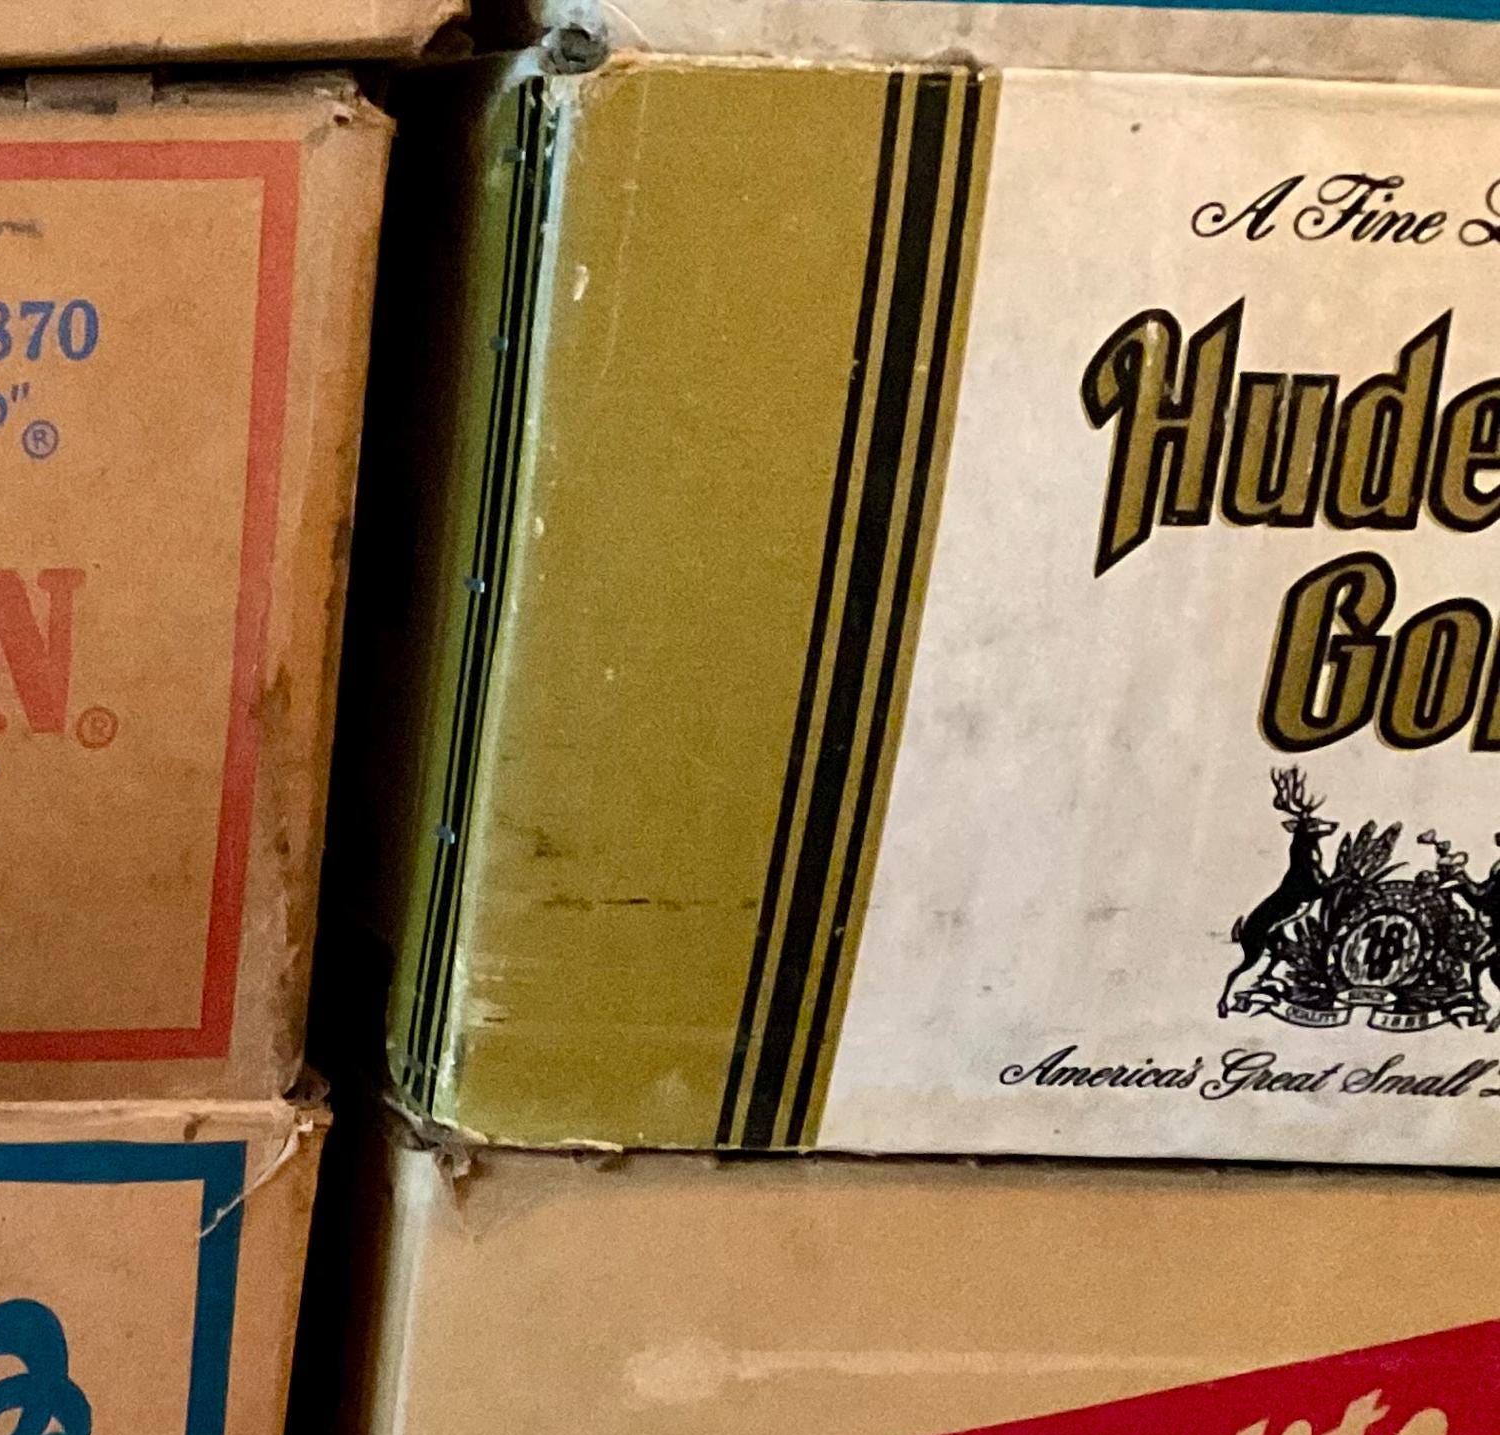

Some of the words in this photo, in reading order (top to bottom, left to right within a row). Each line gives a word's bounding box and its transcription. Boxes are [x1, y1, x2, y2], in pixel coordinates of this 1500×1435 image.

[1192, 174, 1306, 241] A
[1293, 173, 1447, 244] Fine
[999, 1044, 1203, 1089] America's
[1199, 1048, 1344, 1100] Great
[1338, 1054, 1499, 1097] Small
